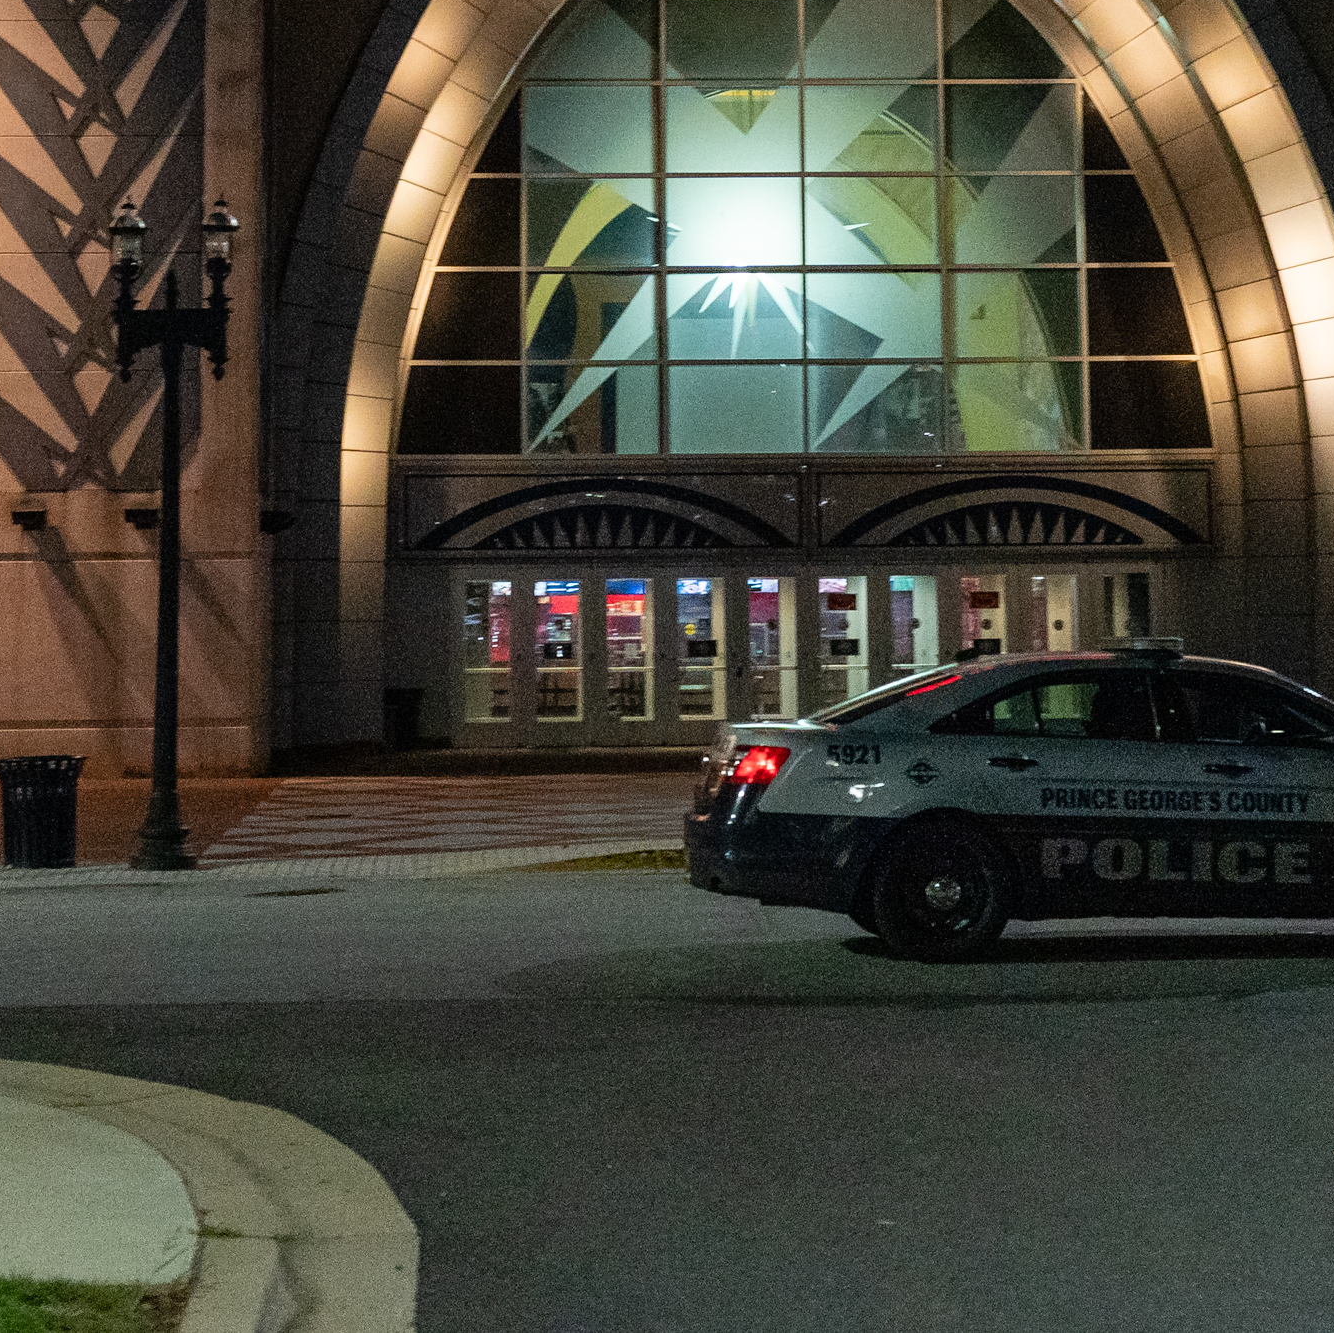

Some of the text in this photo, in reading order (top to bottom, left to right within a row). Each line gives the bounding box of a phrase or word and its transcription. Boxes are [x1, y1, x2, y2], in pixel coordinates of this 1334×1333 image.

[827, 744, 881, 765] 5921
[1041, 788, 1309, 813] PRINCE GEORGE'S COUNTY
[1040, 838, 1312, 883] POLICE
